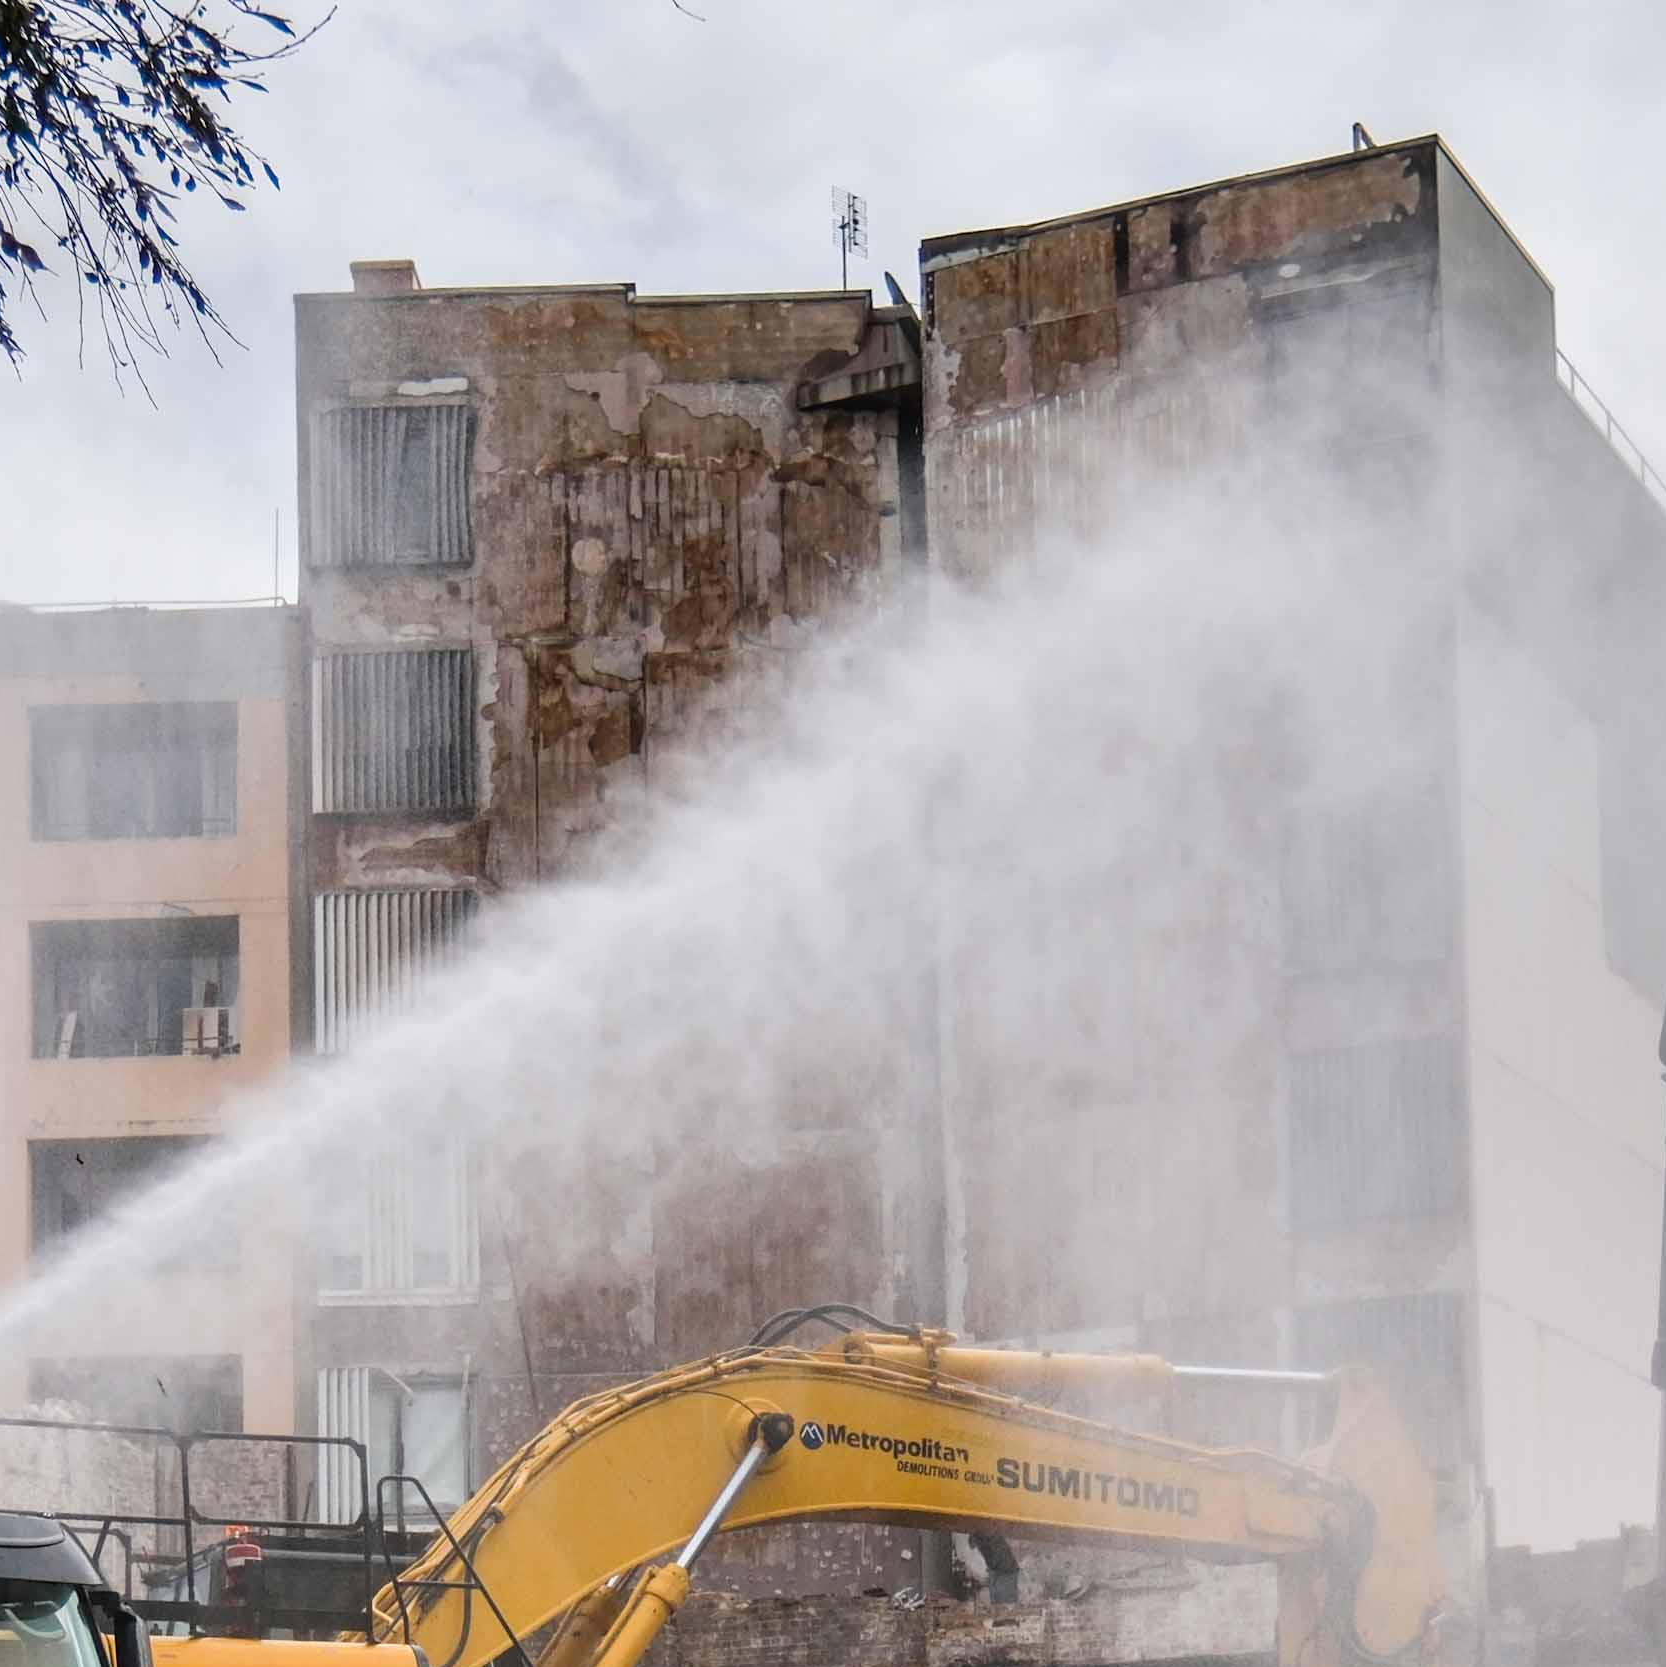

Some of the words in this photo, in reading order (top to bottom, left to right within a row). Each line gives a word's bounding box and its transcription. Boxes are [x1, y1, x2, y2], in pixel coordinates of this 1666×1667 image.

[826, 1424, 969, 1463] Metropolitan
[896, 1460, 960, 1481] DEMOLITIONS
[996, 1457, 1201, 1519] SUMITOMO
